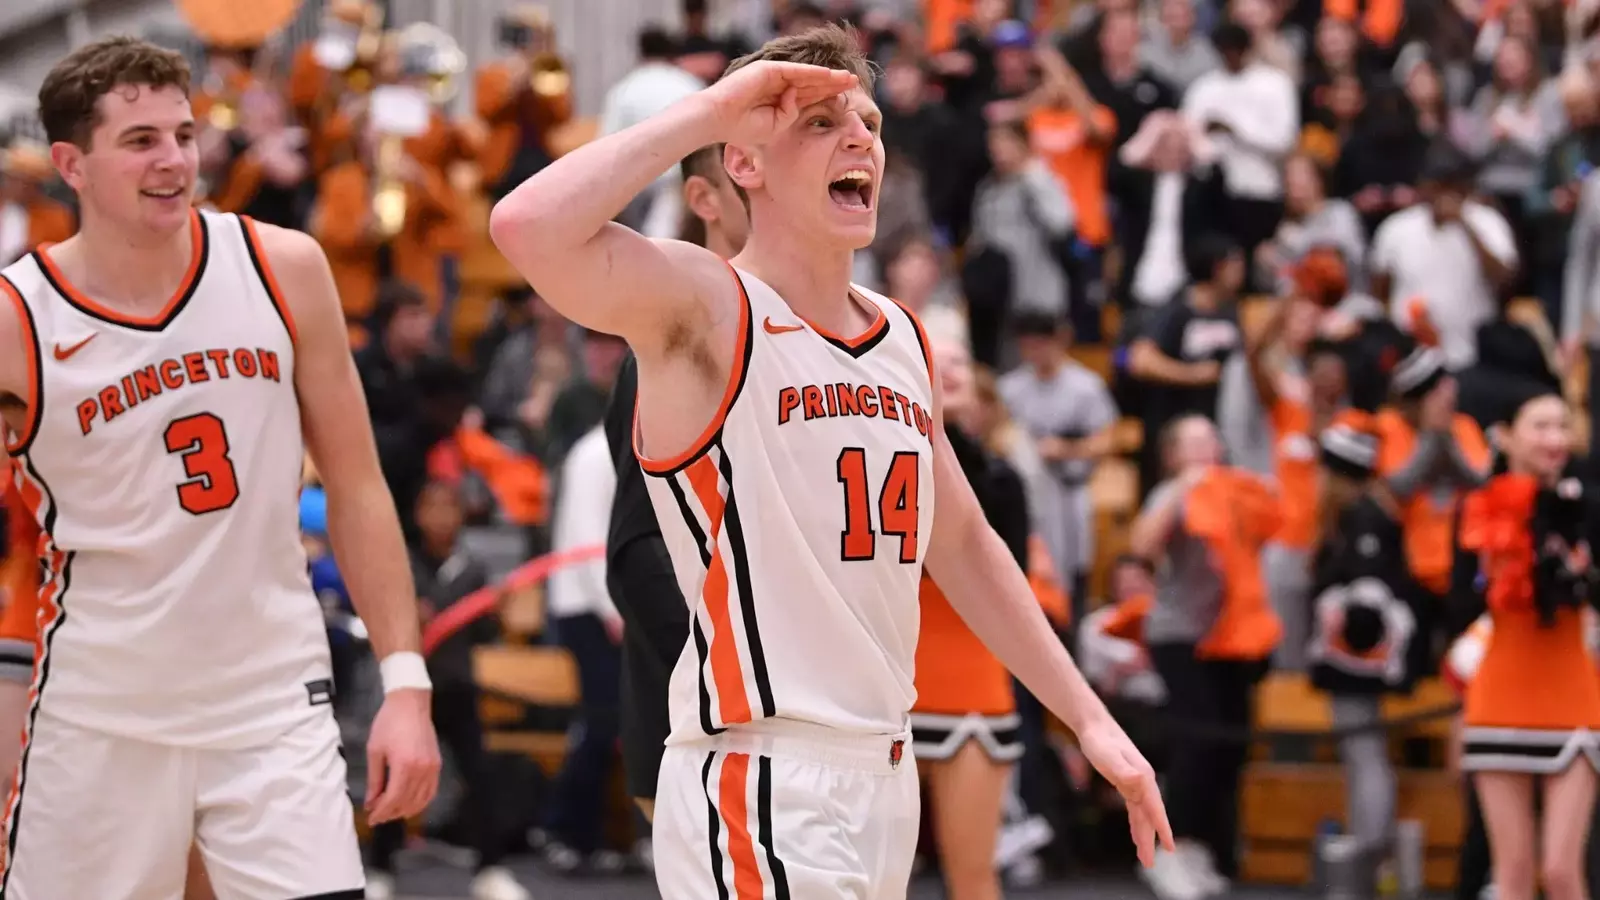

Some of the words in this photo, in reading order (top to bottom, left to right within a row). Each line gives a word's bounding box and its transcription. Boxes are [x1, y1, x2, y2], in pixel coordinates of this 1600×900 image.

[77, 348, 280, 435] PRINCETON
[164, 412, 239, 515] 3
[837, 447, 919, 564] 14
